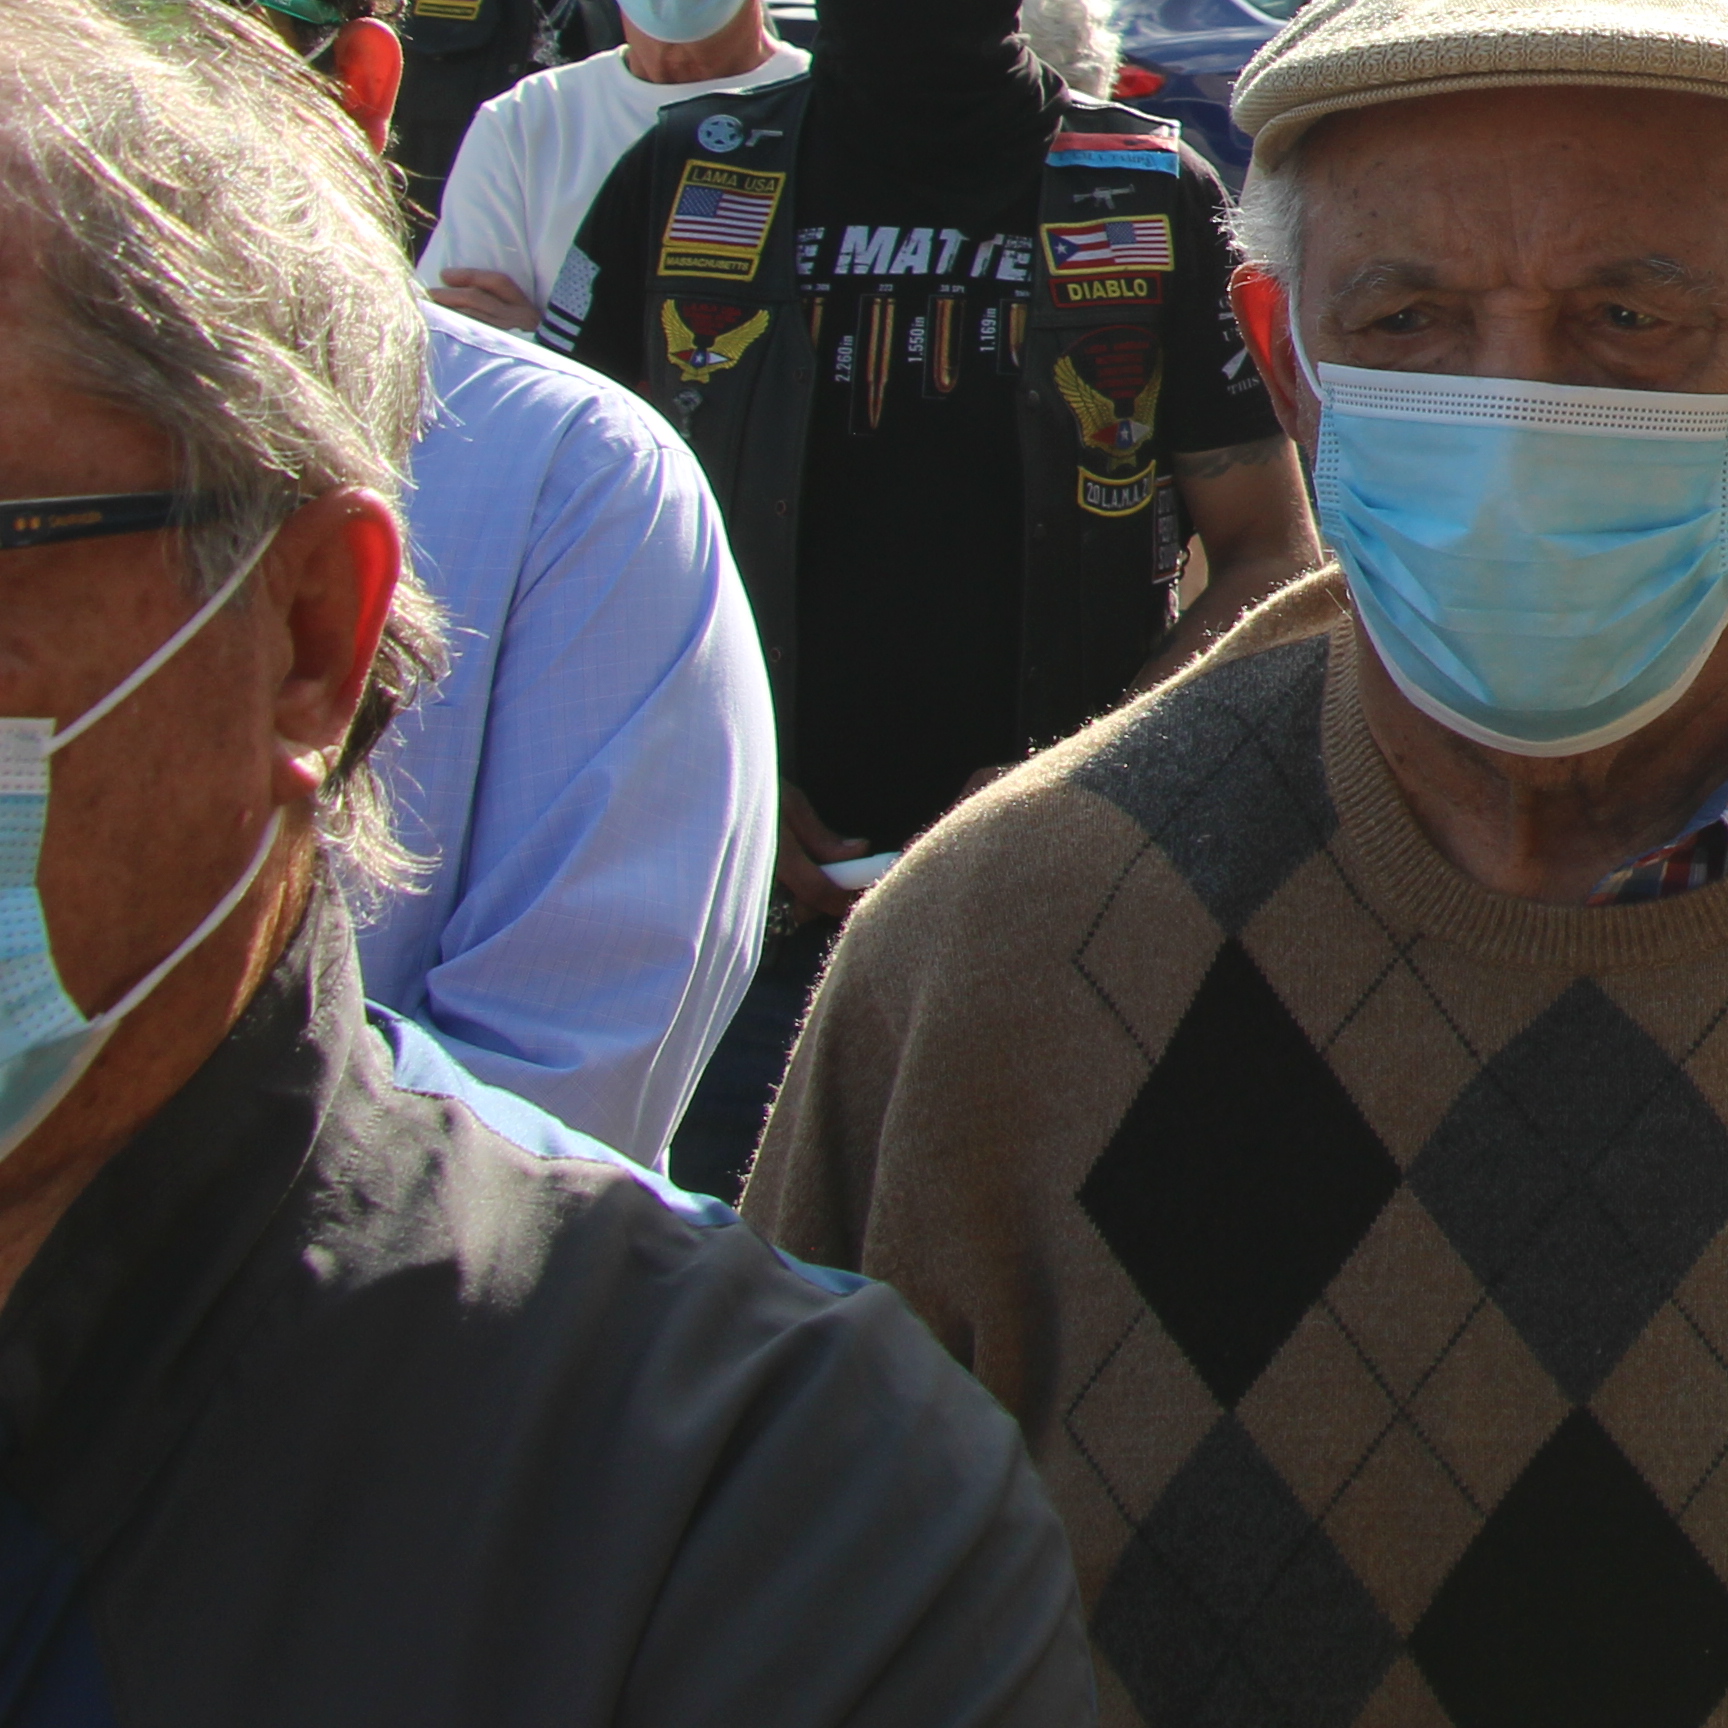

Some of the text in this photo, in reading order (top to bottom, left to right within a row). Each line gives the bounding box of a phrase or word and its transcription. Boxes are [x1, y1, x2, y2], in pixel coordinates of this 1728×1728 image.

[690, 167, 776, 193] LAMA USA
[666, 254, 750, 272] MASSACHUSETTS
[1067, 278, 1147, 301] DIABLO
